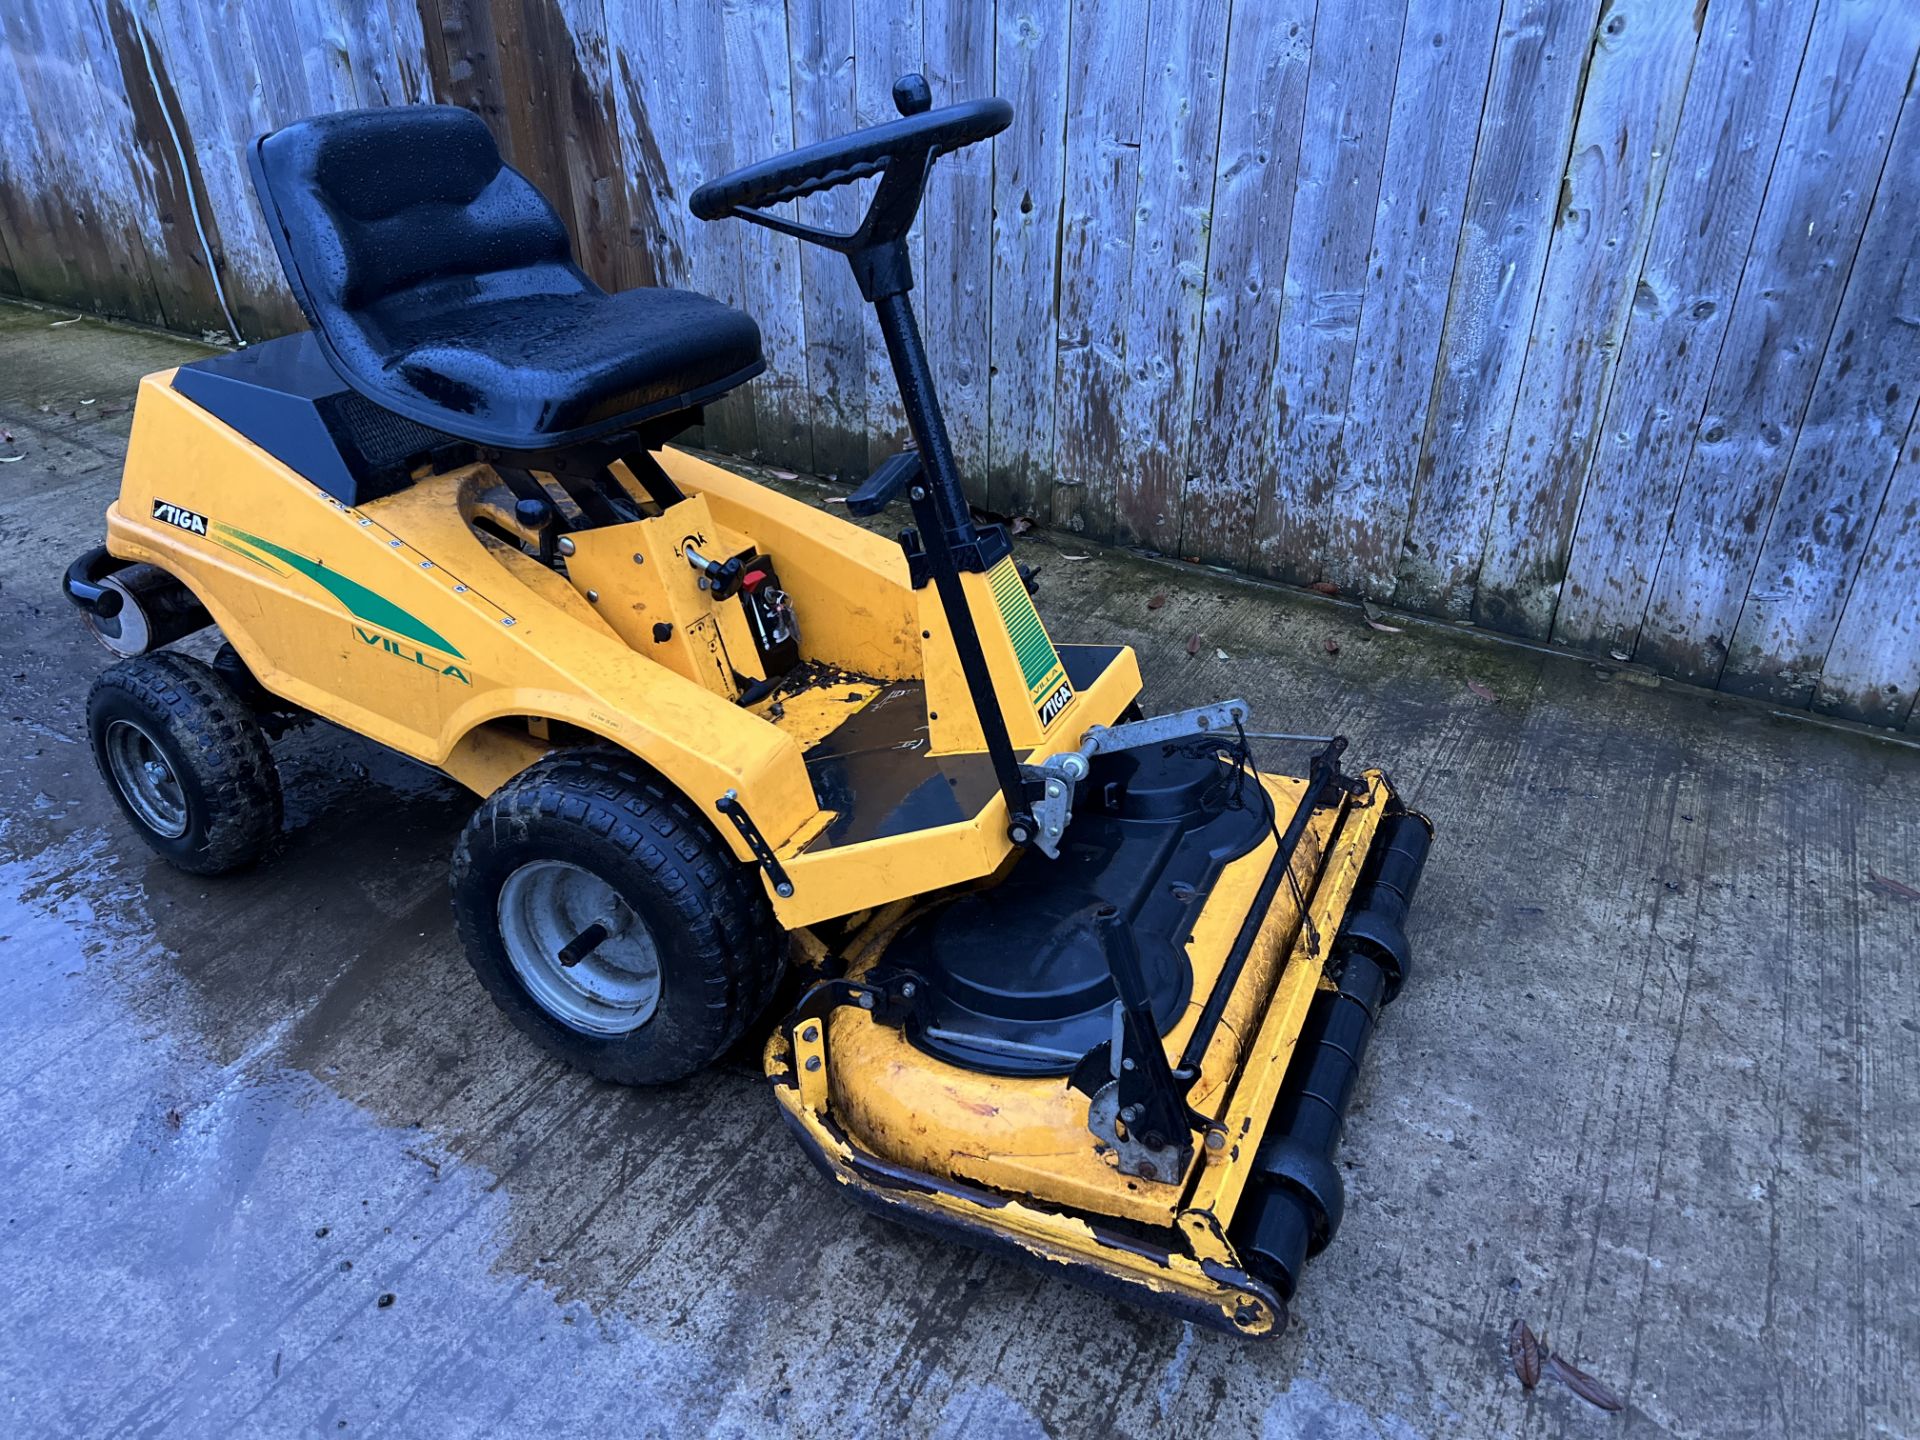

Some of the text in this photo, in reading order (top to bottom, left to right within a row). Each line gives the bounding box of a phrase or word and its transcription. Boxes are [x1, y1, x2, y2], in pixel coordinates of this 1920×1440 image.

[154, 504, 205, 534] STIGA
[355, 626, 469, 684] VILLA
[1033, 669, 1059, 694] VILLA
[1042, 687, 1073, 725] STIGA
